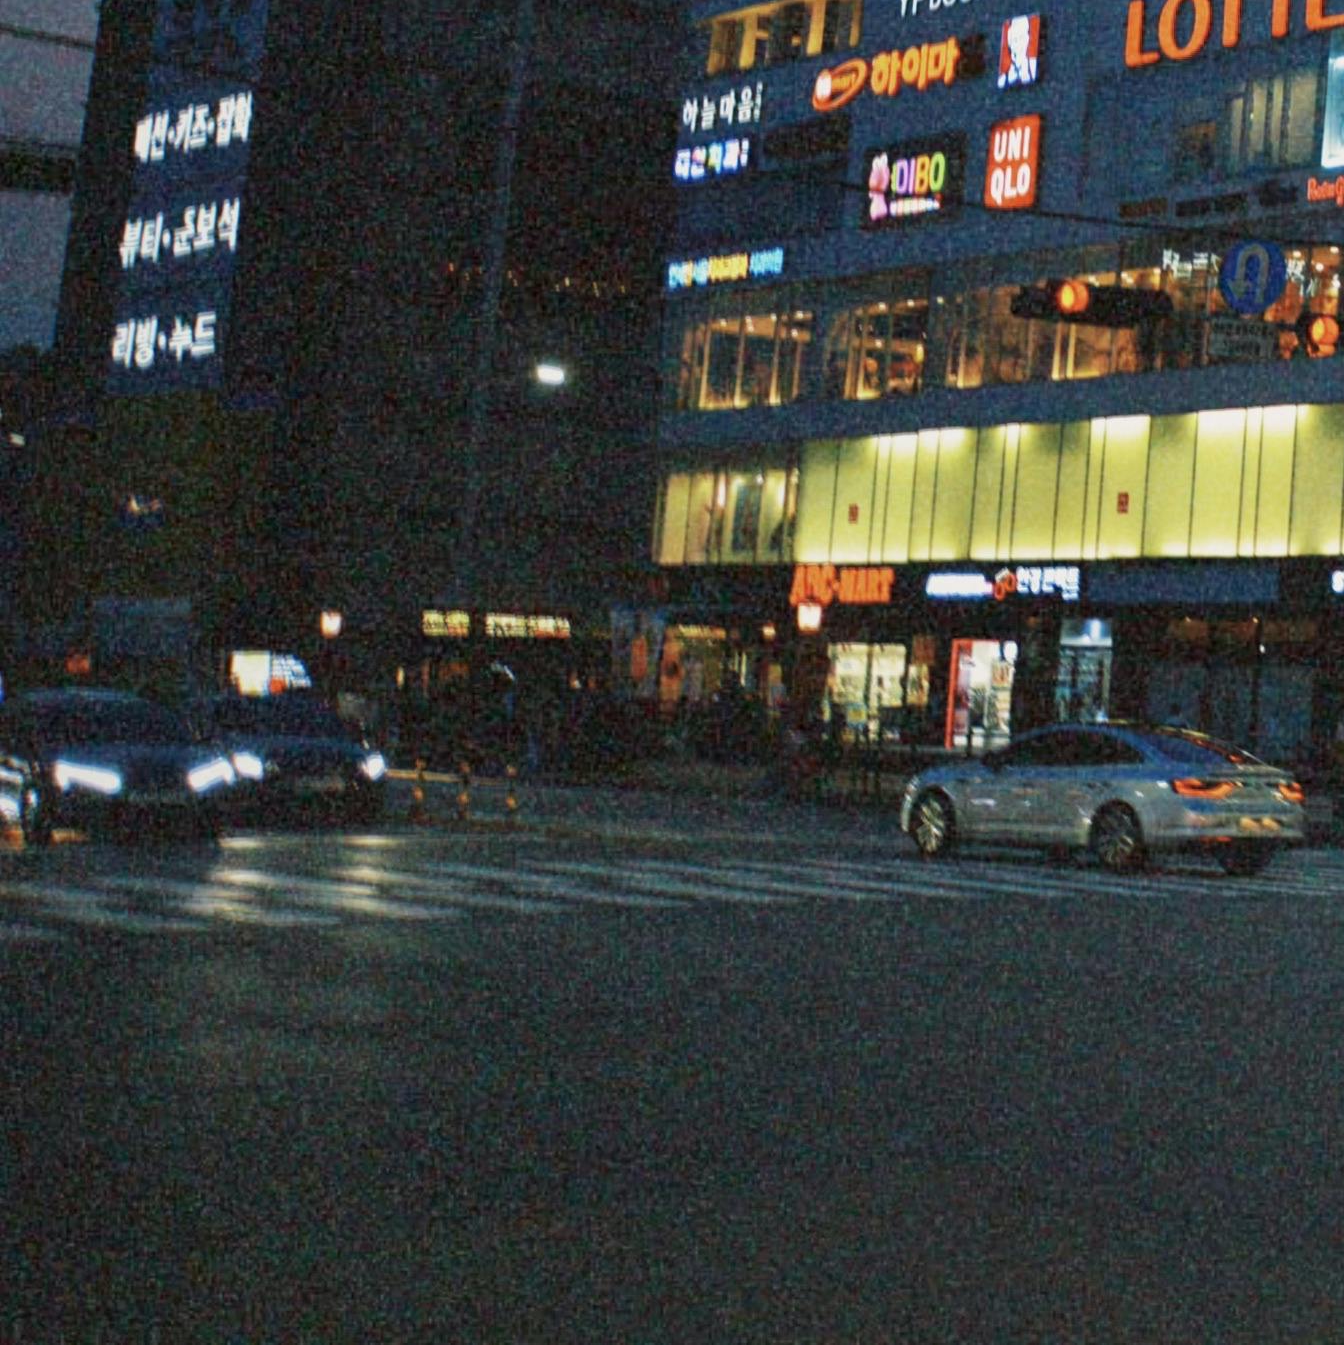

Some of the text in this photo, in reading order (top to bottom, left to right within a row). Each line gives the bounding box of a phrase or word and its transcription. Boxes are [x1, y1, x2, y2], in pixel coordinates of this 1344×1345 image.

[993, 126, 1031, 164] UNI
[893, 152, 945, 194] DIBO
[990, 167, 1031, 206] QLO
